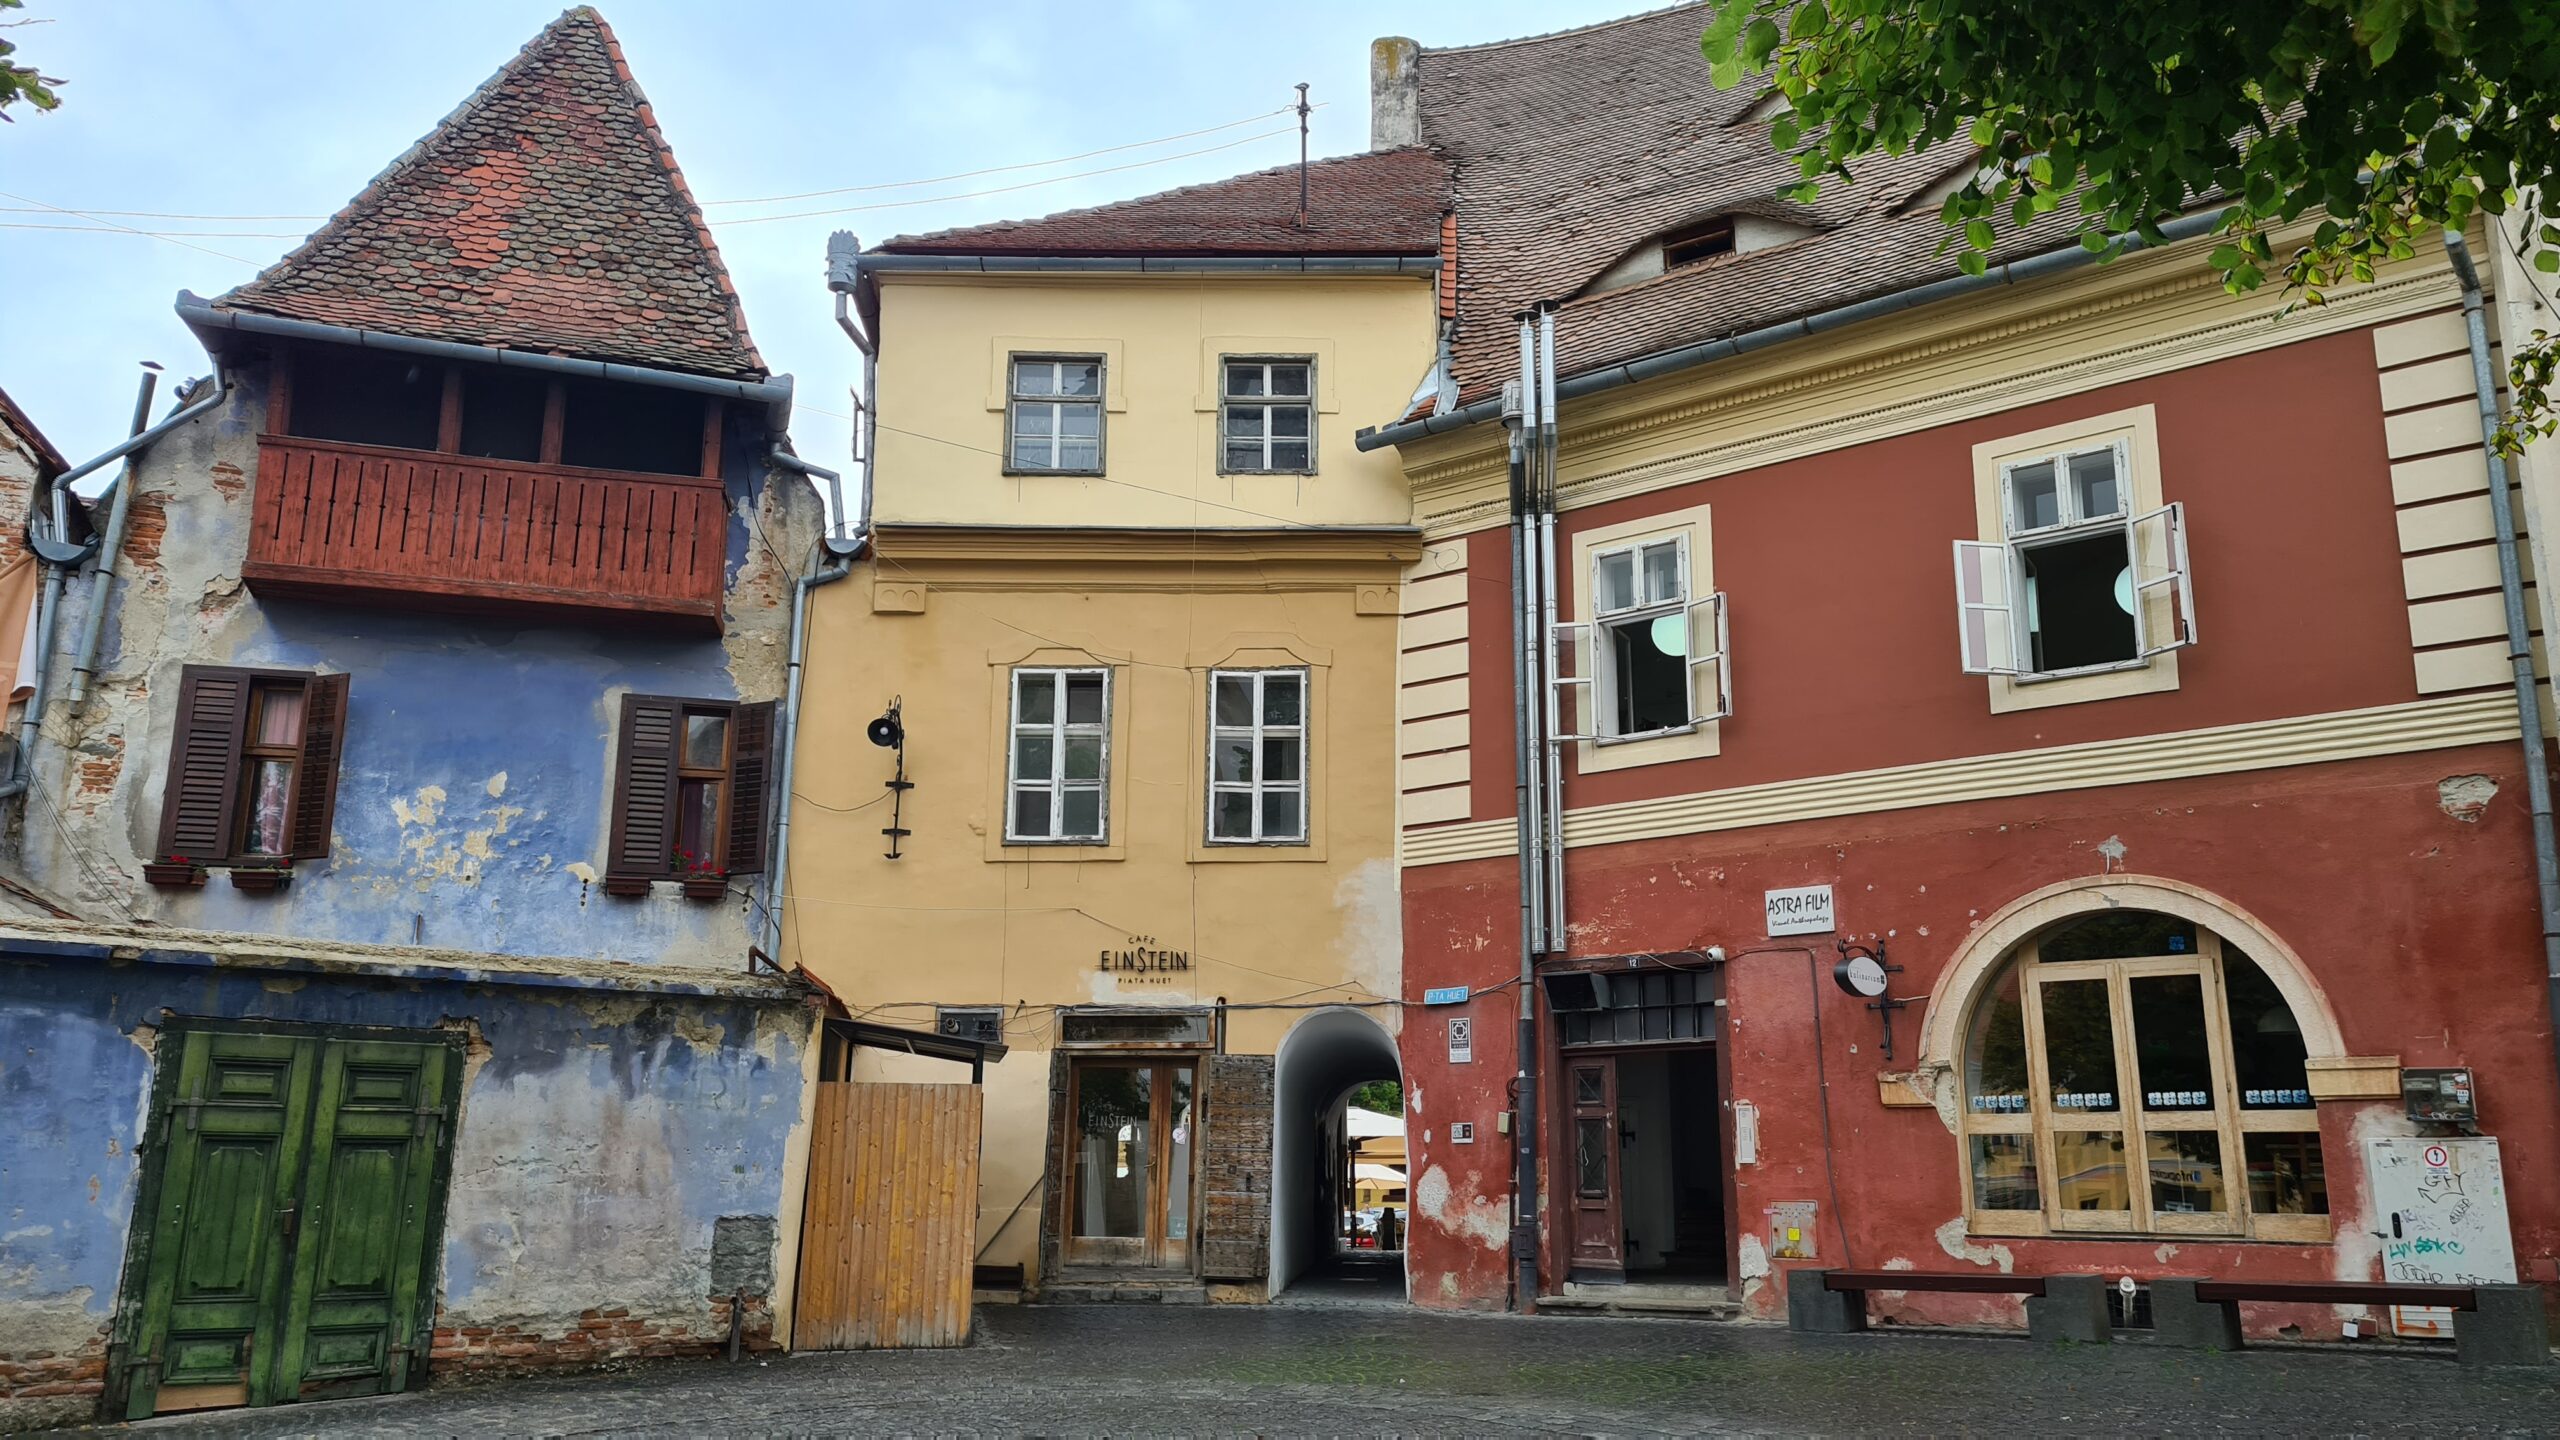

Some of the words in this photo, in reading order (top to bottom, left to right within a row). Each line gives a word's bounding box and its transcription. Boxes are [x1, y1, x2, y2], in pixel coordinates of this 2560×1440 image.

[1768, 896, 1802, 916] ASTRA
[1806, 893, 1830, 912] FILM
[1772, 919, 1790, 927] Visual
[1791, 915, 1829, 925] Anthropology
[1629, 959, 1637, 967] 12
